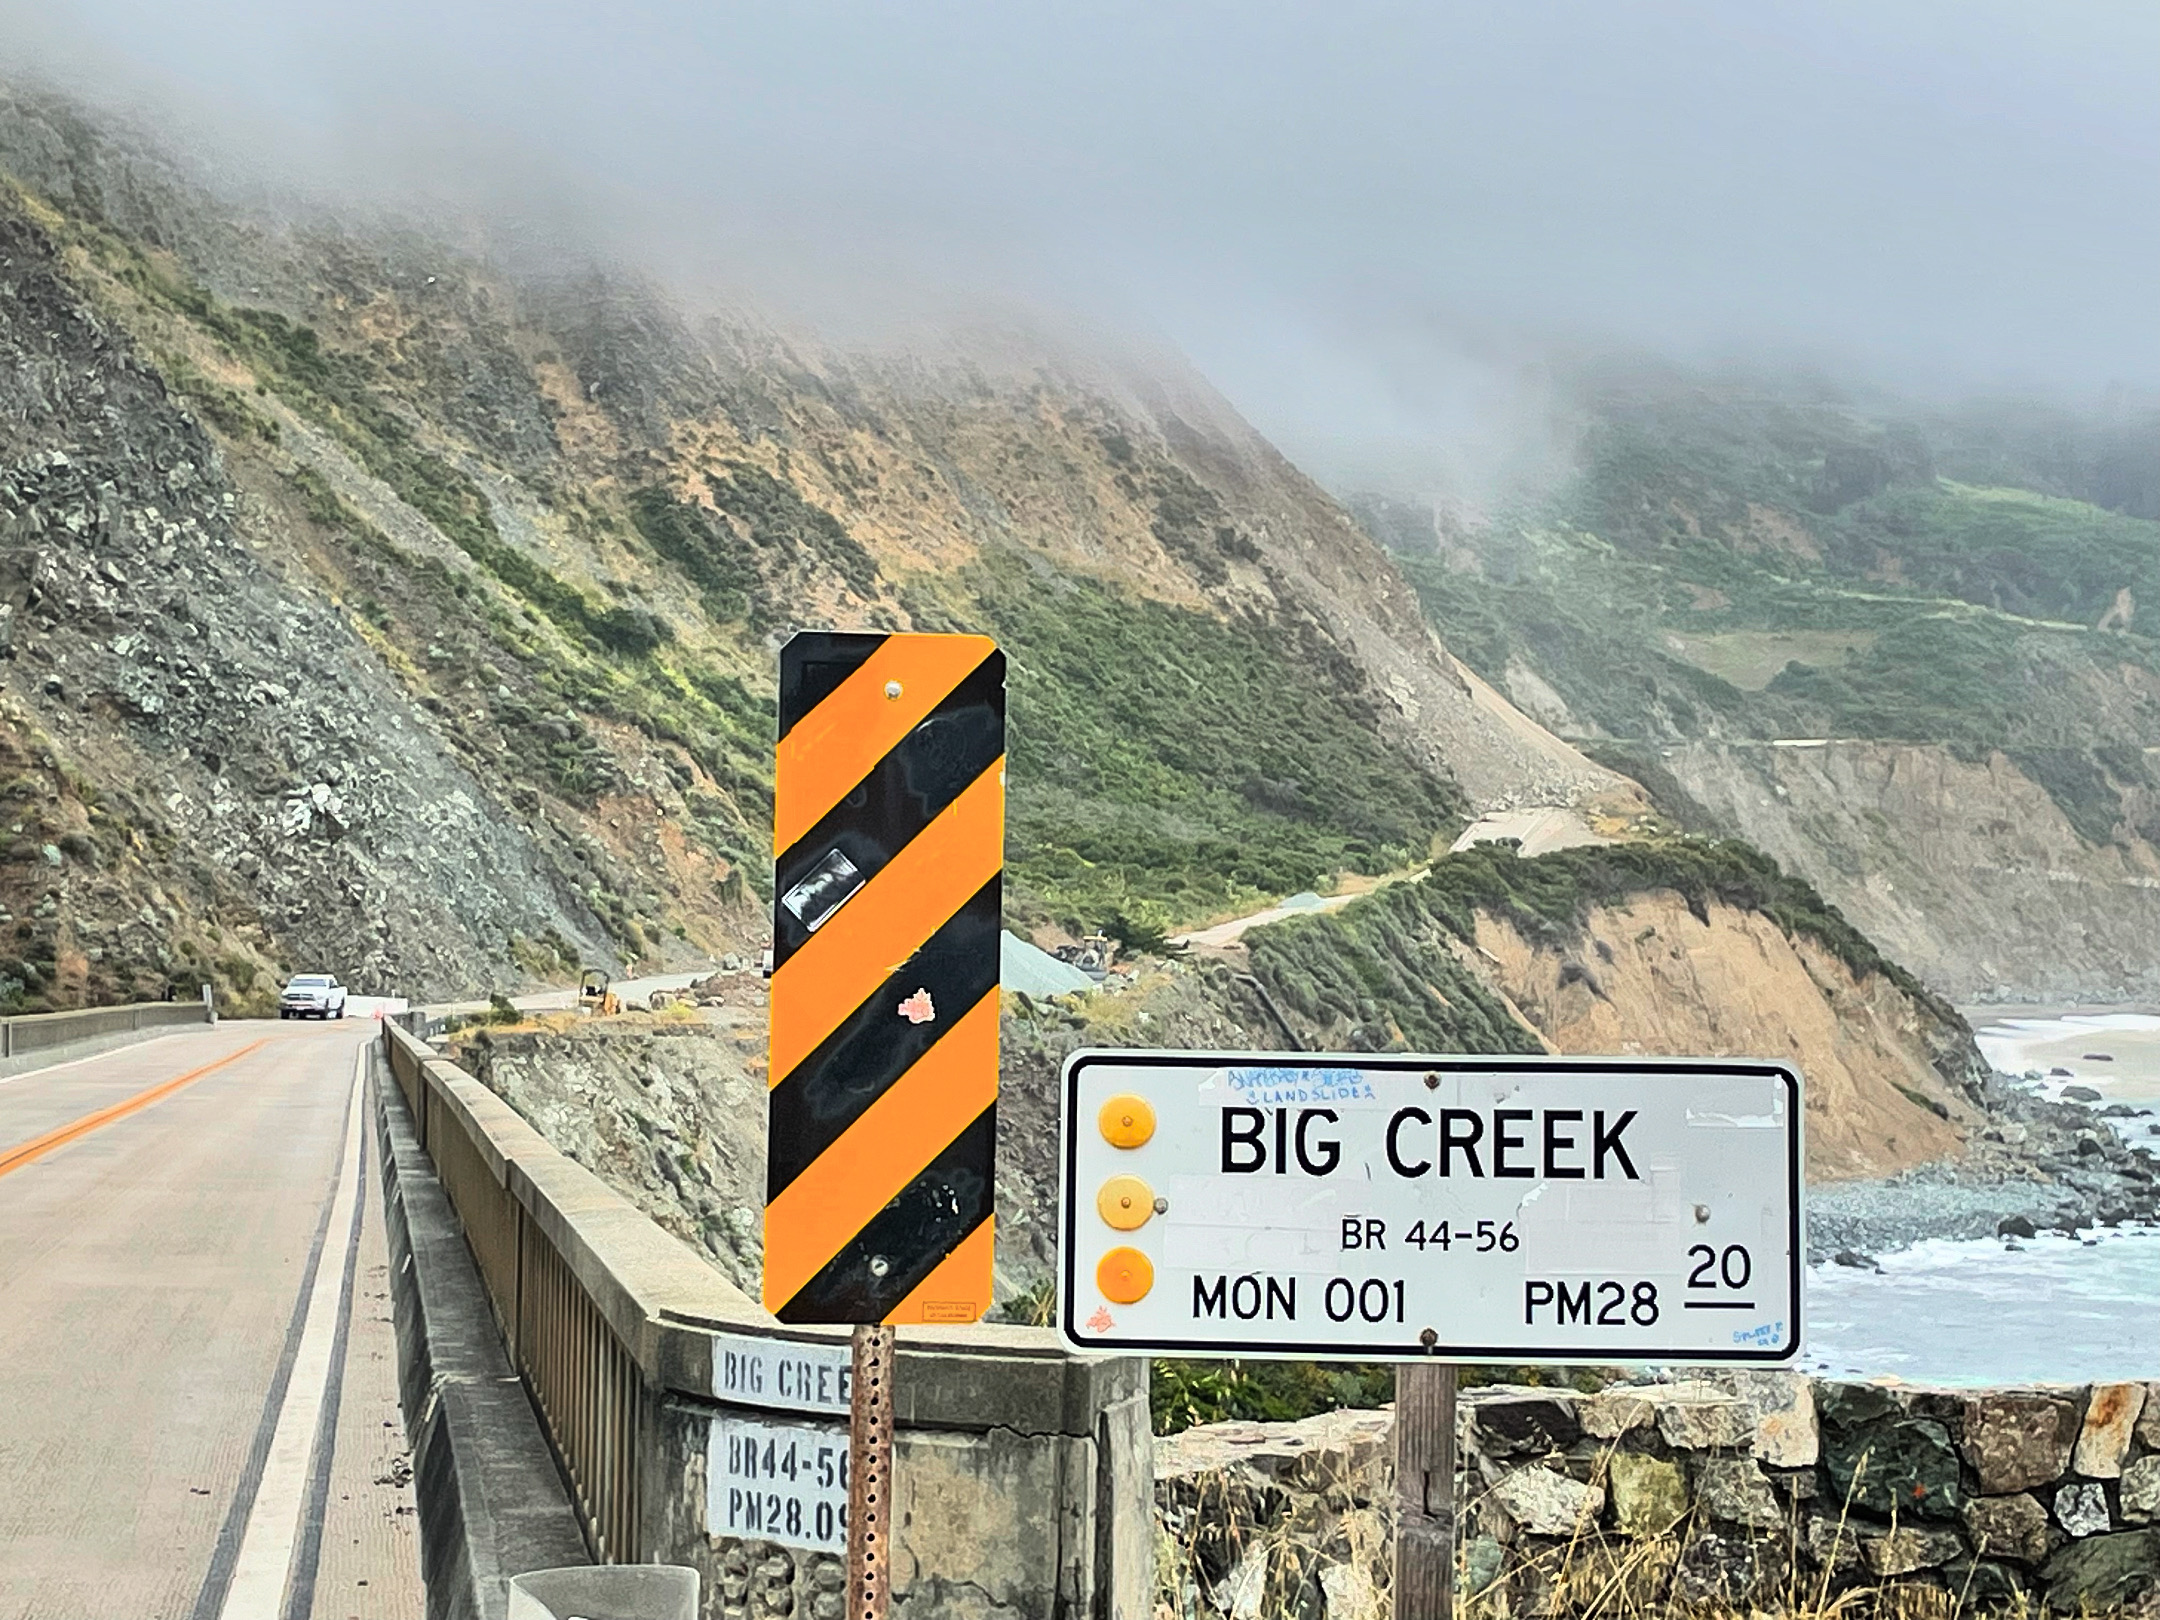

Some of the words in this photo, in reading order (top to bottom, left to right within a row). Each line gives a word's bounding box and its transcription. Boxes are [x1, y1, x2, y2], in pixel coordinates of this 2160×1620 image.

[1221, 1106, 1341, 1177] BIG
[1386, 1108, 1641, 1180] CREEK
[1342, 1218, 1386, 1250] BR
[1404, 1220, 1520, 1253] 44-56
[1687, 1244, 1751, 1290] 20
[1192, 1275, 1296, 1321] MON
[1324, 1277, 1404, 1323] 001
[1525, 1280, 1660, 1327] PM28
[725, 1351, 763, 1393] BIG
[778, 1359, 853, 1405] CREE
